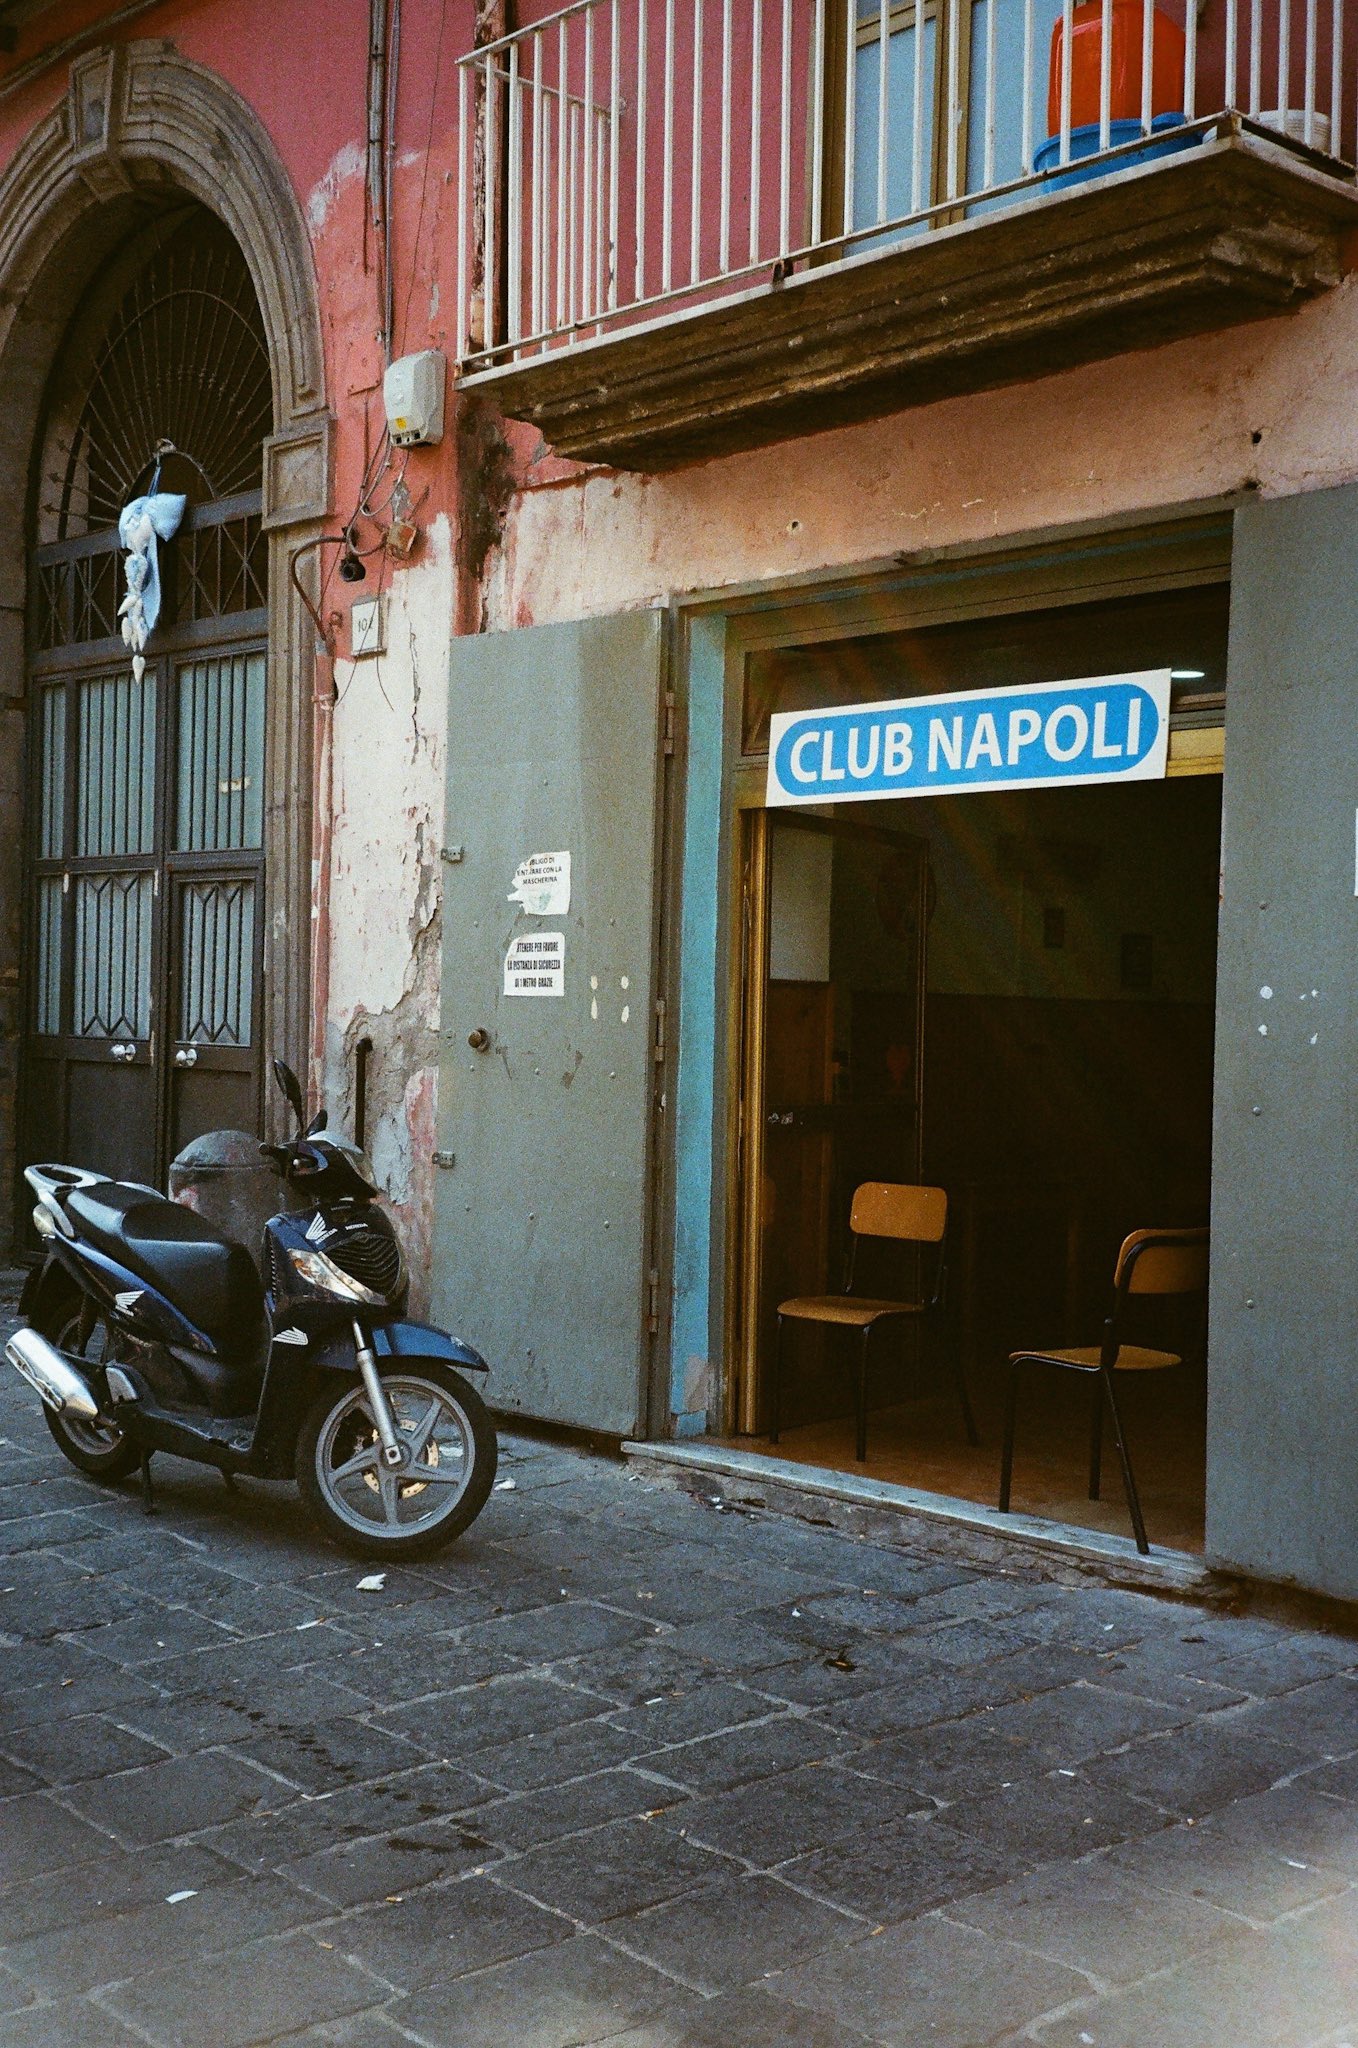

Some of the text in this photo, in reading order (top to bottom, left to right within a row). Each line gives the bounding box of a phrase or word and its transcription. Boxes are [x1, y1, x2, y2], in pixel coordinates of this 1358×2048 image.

[790, 698, 1142, 783] CLUB NAPOLI
[522, 876, 558, 885] MASCHERINA
[534, 942, 542, 952] PER
[543, 941, 559, 952] FAVORE
[507, 959, 561, 970] LA DISTANZA DI SICUREZZA
[523, 977, 537, 987] METRO
